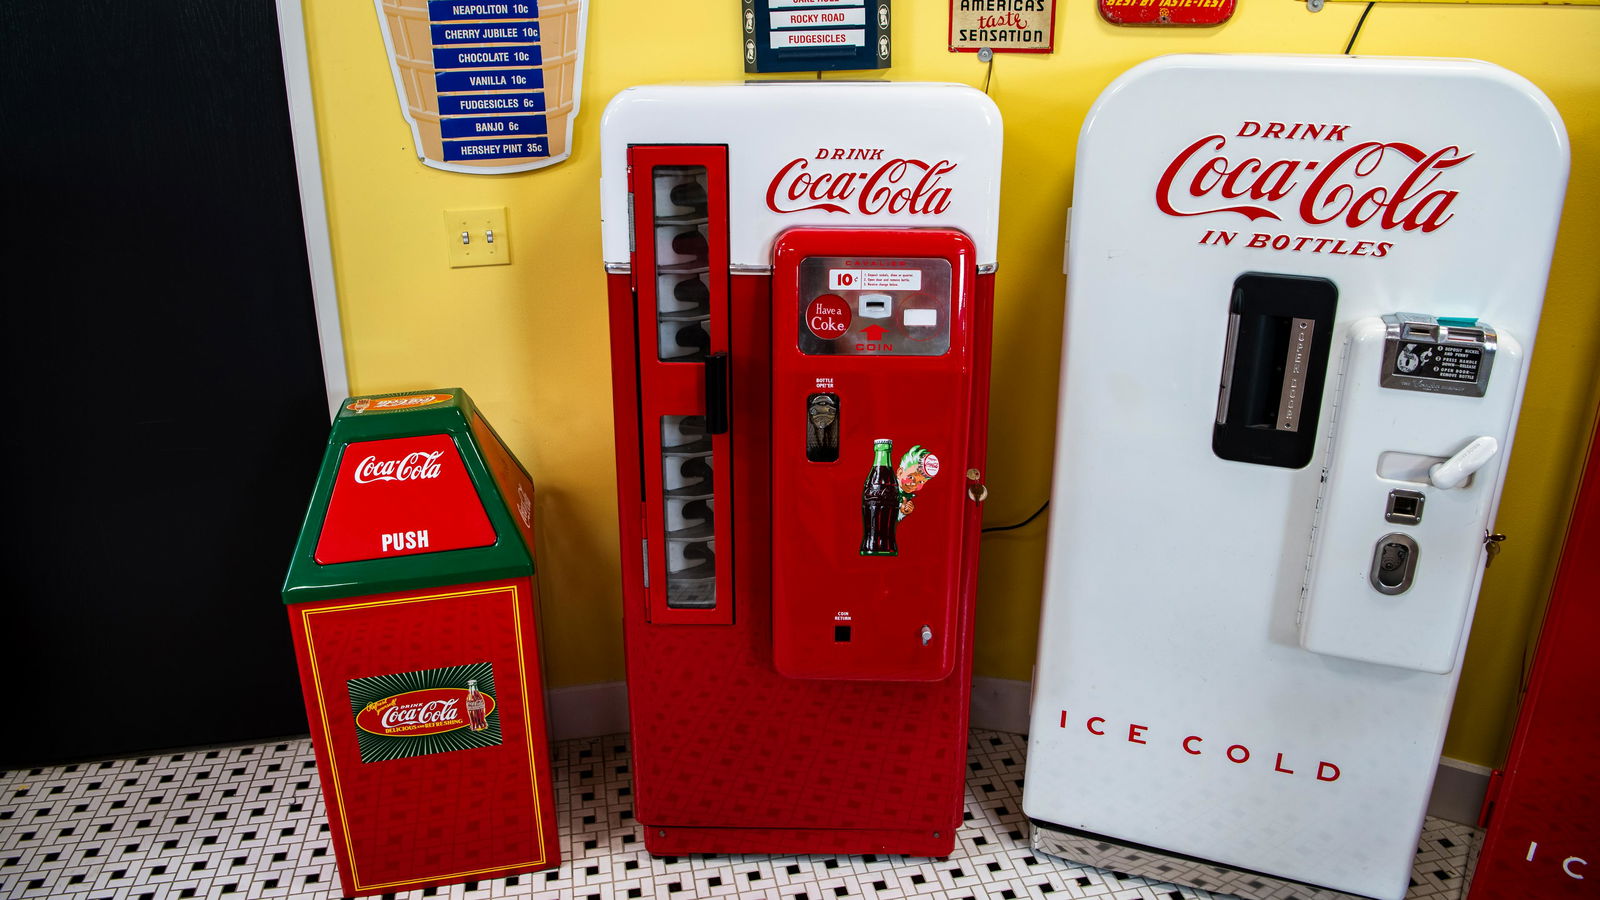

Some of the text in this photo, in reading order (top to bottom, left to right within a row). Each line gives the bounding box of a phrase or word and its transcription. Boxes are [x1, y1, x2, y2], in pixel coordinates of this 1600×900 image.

[453, 4, 529, 15] NEAPOLITON 10c
[790, 13, 845, 24] ROCKY ROAD
[977, 11, 1028, 30] taste
[445, 28, 538, 39] CHERRY JUBILEE 10c
[788, 34, 847, 44] FUDGESICLES
[959, 29, 1043, 42] SENSATION
[458, 51, 530, 63] CHOCOLATE 10c
[469, 75, 527, 86] VANILLA 10c
[460, 99, 534, 110] FUDGESICLES 6c
[475, 121, 519, 132] BANJO 6c
[1236, 120, 1352, 142] DRINK
[461, 143, 543, 156] HERSHEY PINT 35c
[815, 148, 885, 160] DRINK
[765, 157, 958, 216] Coca-Cola
[1155, 133, 1476, 233] Coca-Cola
[1198, 230, 1395, 258] IN BOTTLES
[816, 303, 836, 315] Have
[811, 316, 845, 332] Coke
[855, 343, 893, 351] COIN
[354, 450, 445, 484] Coca-Cola
[381, 529, 430, 552] PUSH
[400, 702, 424, 710] DRINK
[381, 698, 460, 729] Coca-Cola
[385, 724, 417, 734] DELICIOUS
[424, 719, 464, 728] REFRESHING
[1060, 709, 1341, 783] ICE COLD
